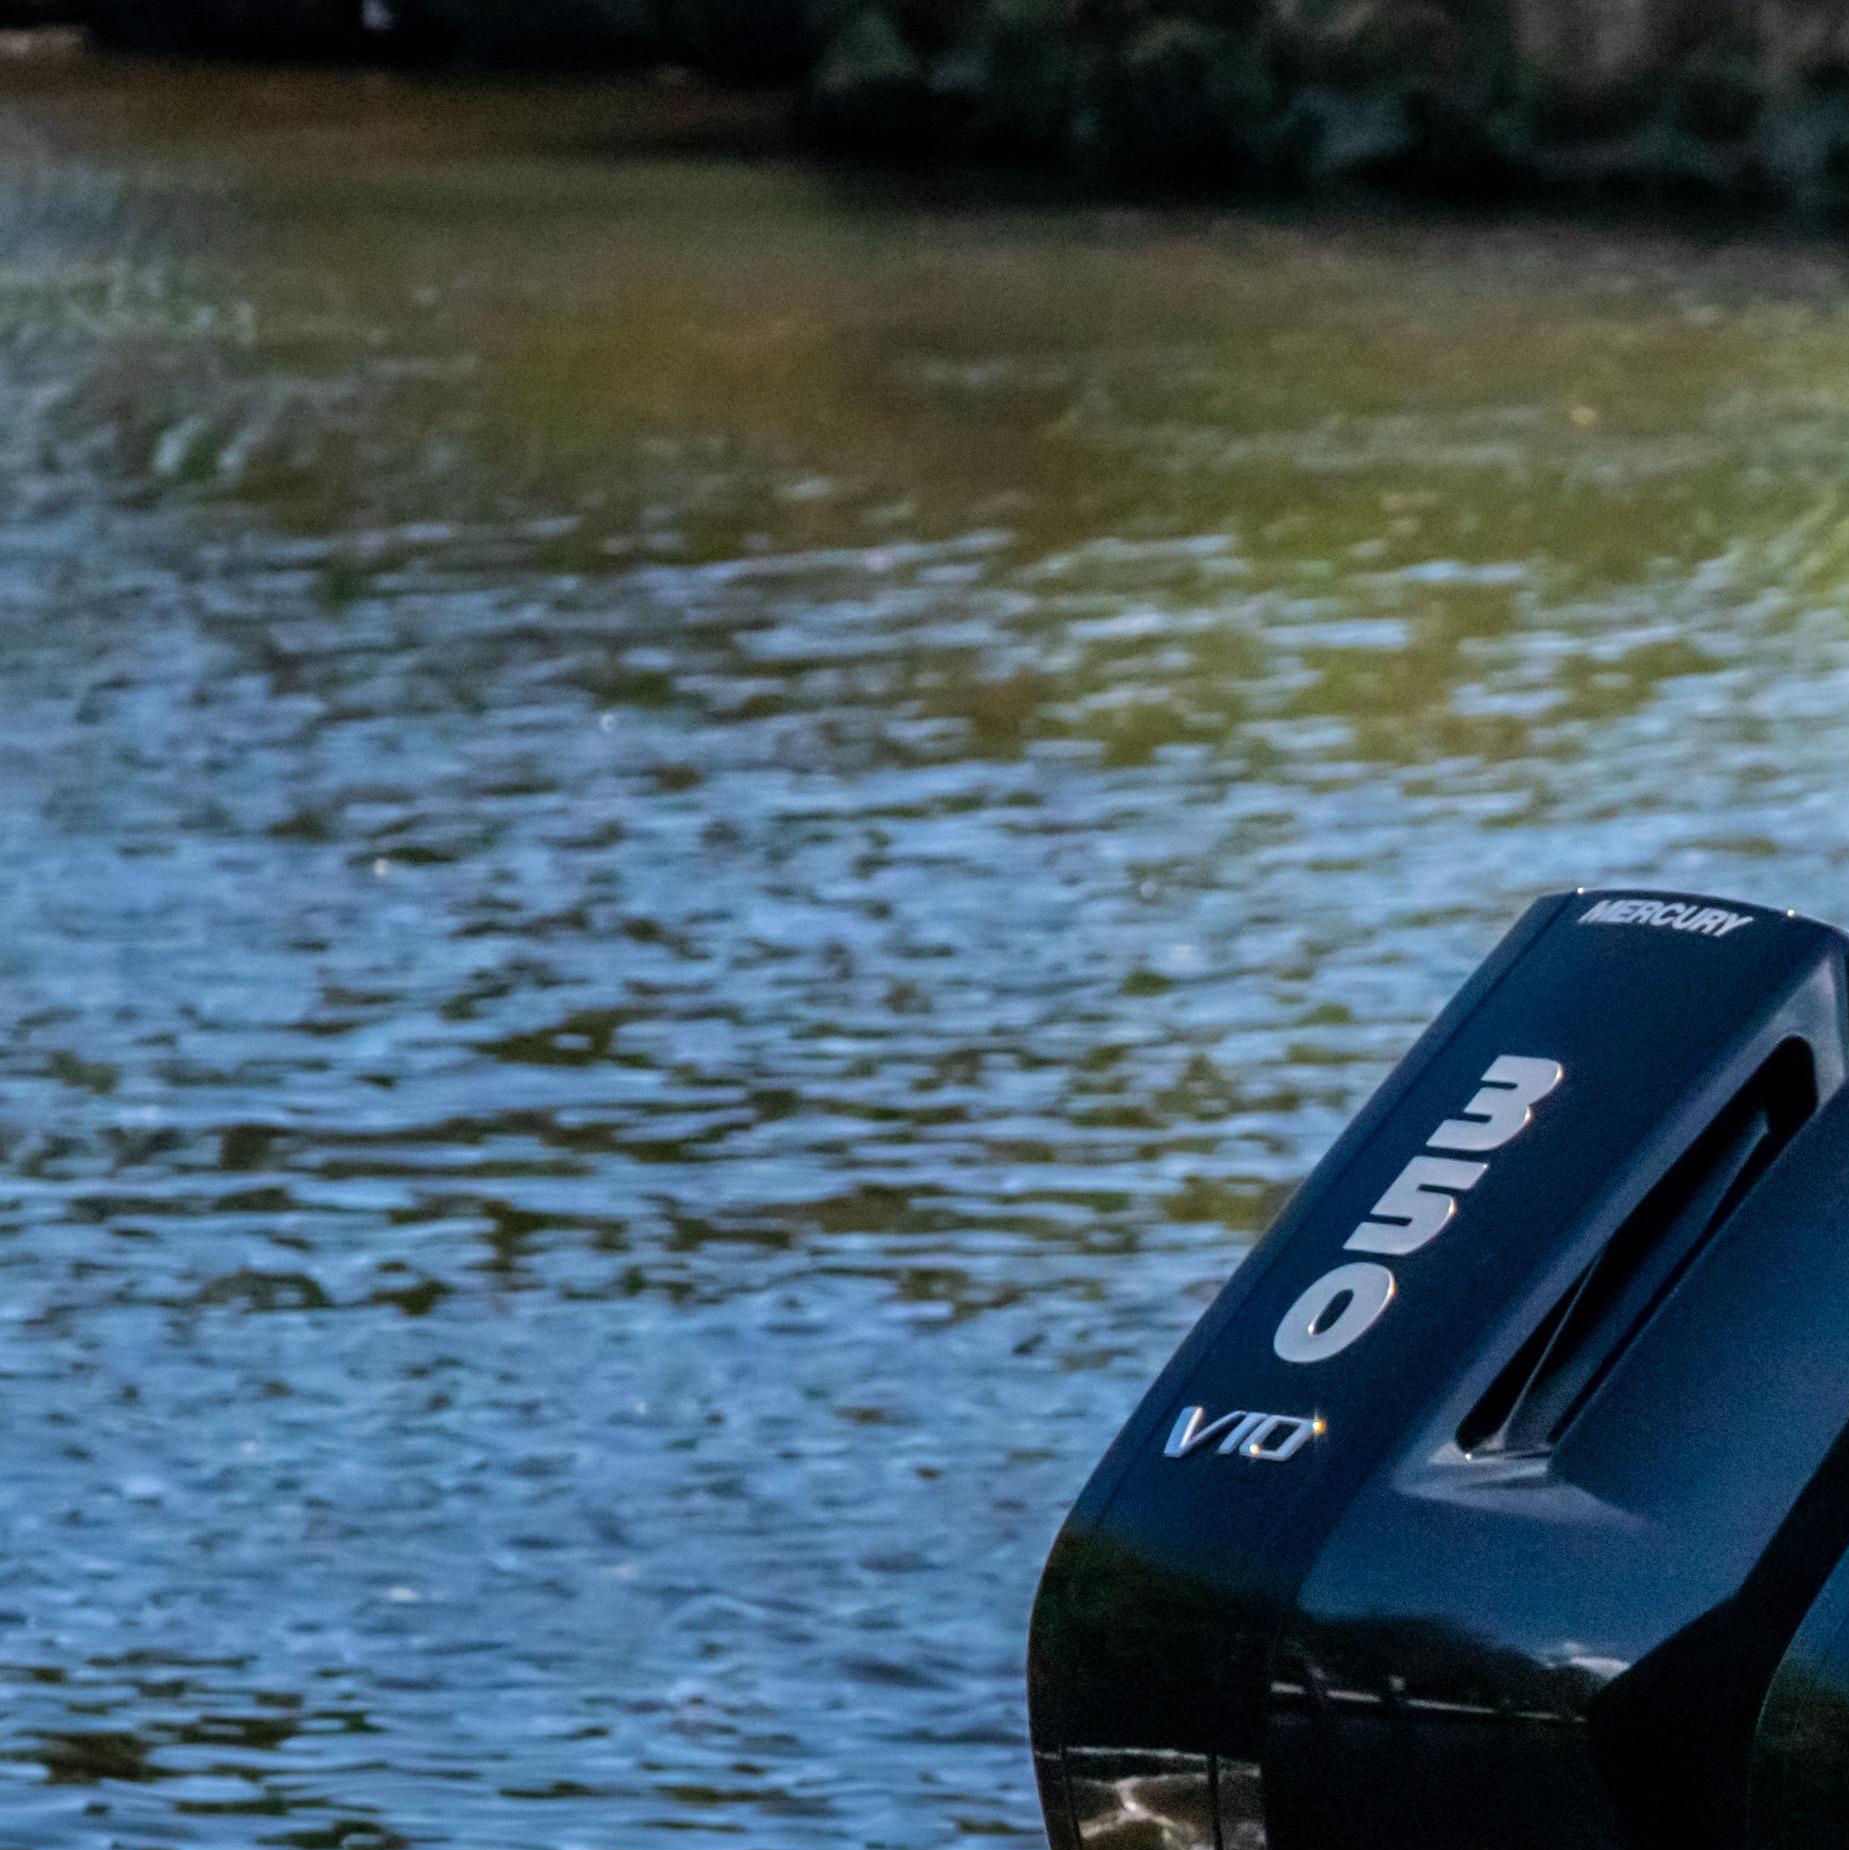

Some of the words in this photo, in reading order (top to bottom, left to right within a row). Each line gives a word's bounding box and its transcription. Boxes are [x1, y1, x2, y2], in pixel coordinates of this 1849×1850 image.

[1577, 899, 1755, 938] MERCURY
[1273, 1054, 1565, 1364] 350
[1164, 1405, 1326, 1462] V10
